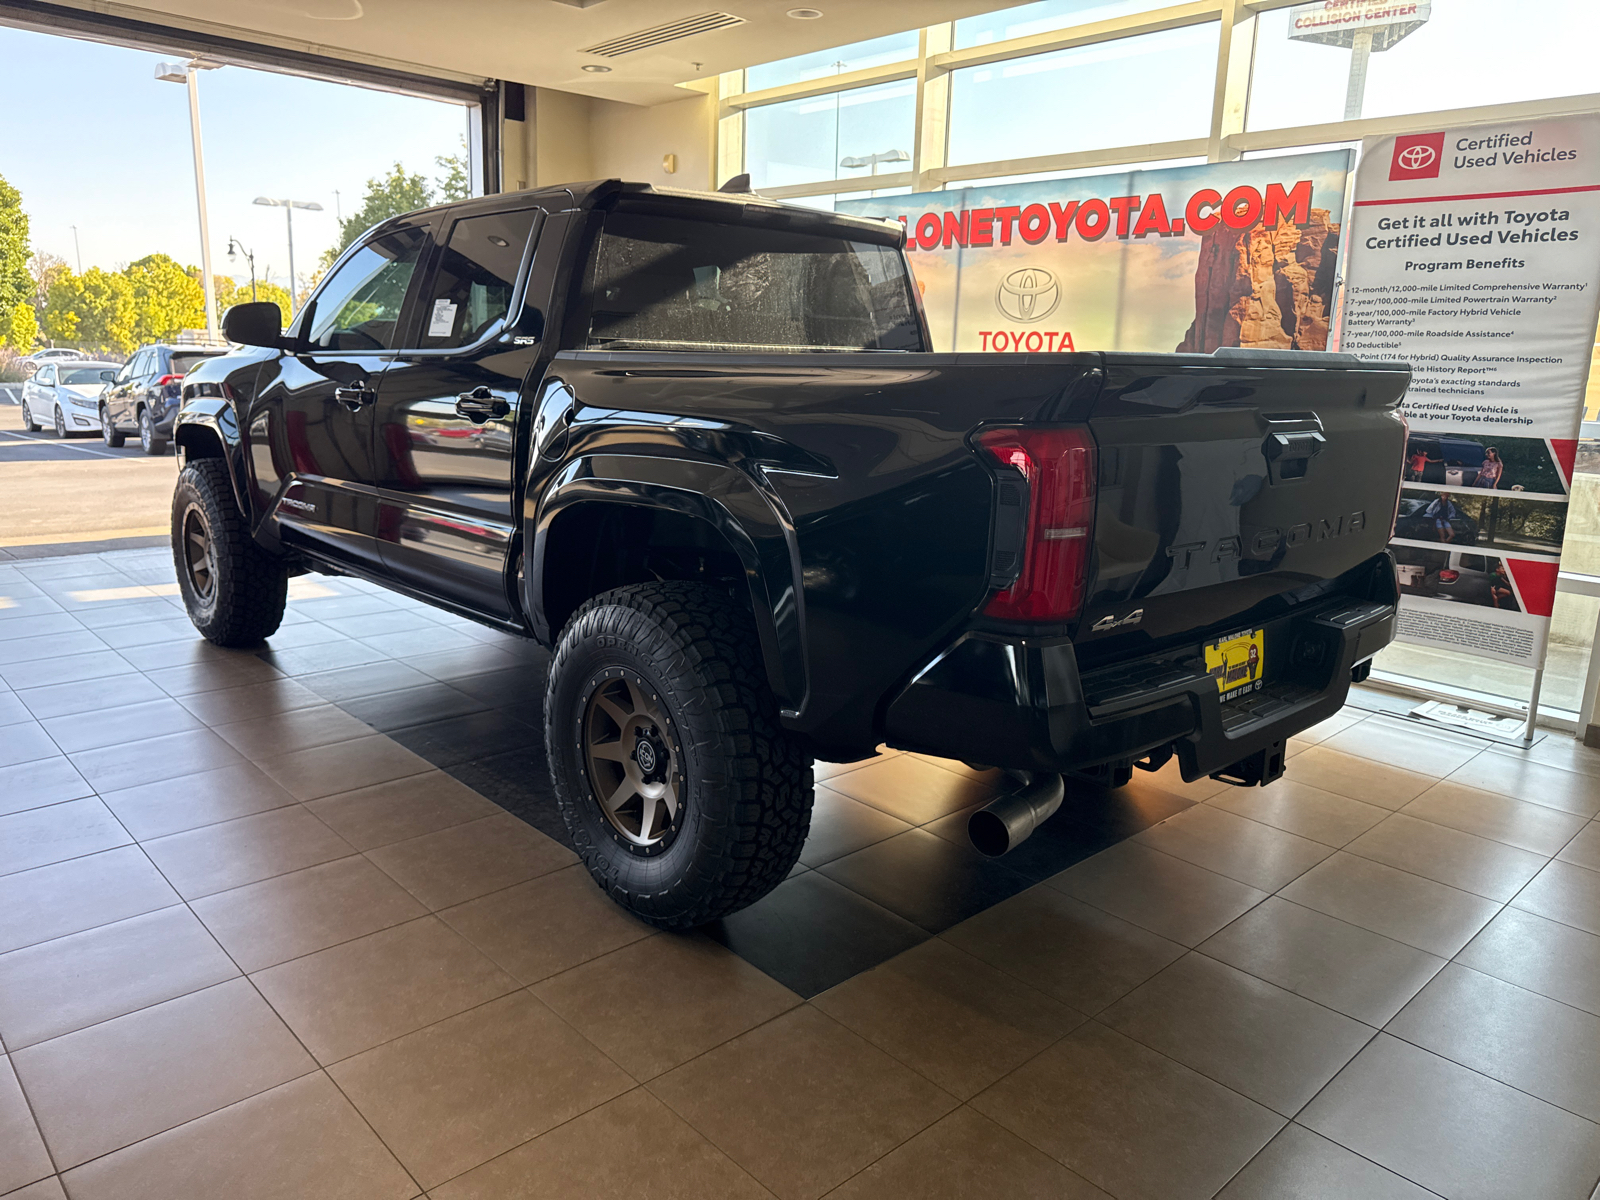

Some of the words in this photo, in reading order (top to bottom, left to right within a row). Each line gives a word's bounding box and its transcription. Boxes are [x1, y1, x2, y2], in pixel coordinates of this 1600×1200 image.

[1294, 11, 1360, 29] COLLISION
[1365, 3, 1416, 20] CENTER
[1456, 131, 1533, 151] Certified
[1454, 152, 1497, 168] Used
[1502, 148, 1577, 165] Vehicles
[1378, 216, 1408, 230] Get
[1413, 216, 1426, 228] it
[1430, 214, 1452, 228] all
[1458, 211, 1498, 226] with
[1504, 208, 1570, 228] Toyota
[1366, 232, 1441, 250] Certified
[1446, 230, 1492, 246] Used
[1498, 228, 1579, 244] Vehicles
[1404, 260, 1462, 272] Program
[1466, 258, 1525, 269] Benefits
[1351, 284, 1438, 294] 12-month/12,000-mile
[1440, 284, 1470, 292] Limited
[1472, 282, 1540, 292] Comprehensive
[1350, 297, 1428, 306] 7-year/100,000-mile
[1348, 309, 1426, 318] 8-year/100,000-mile
[1460, 308, 1488, 316] Hybrid
[1347, 330, 1424, 338] 7-year/100,000-mile
[979, 331, 1075, 353] TOYOTA
[1410, 354, 1439, 362] Hybrid)
[1440, 354, 1470, 362] Quality
[1516, 356, 1562, 364] Inspection
[1440, 378, 1476, 387] exacting
[1478, 380, 1520, 388] standards
[1438, 387, 1484, 395] technicians
[1412, 402, 1450, 411] Certified
[1452, 404, 1474, 412] Used
[1476, 405, 1509, 414] Vehicle
[1429, 414, 1450, 422] your
[1451, 414, 1481, 422] Toyota
[1483, 416, 1534, 426] dealership
[1165, 510, 1366, 570] TACOMA
[596, 635, 639, 657] OPEN
[1250, 648, 1256, 658] 32
[1226, 690, 1238, 700] MAKE
[1242, 684, 1252, 694] EASY
